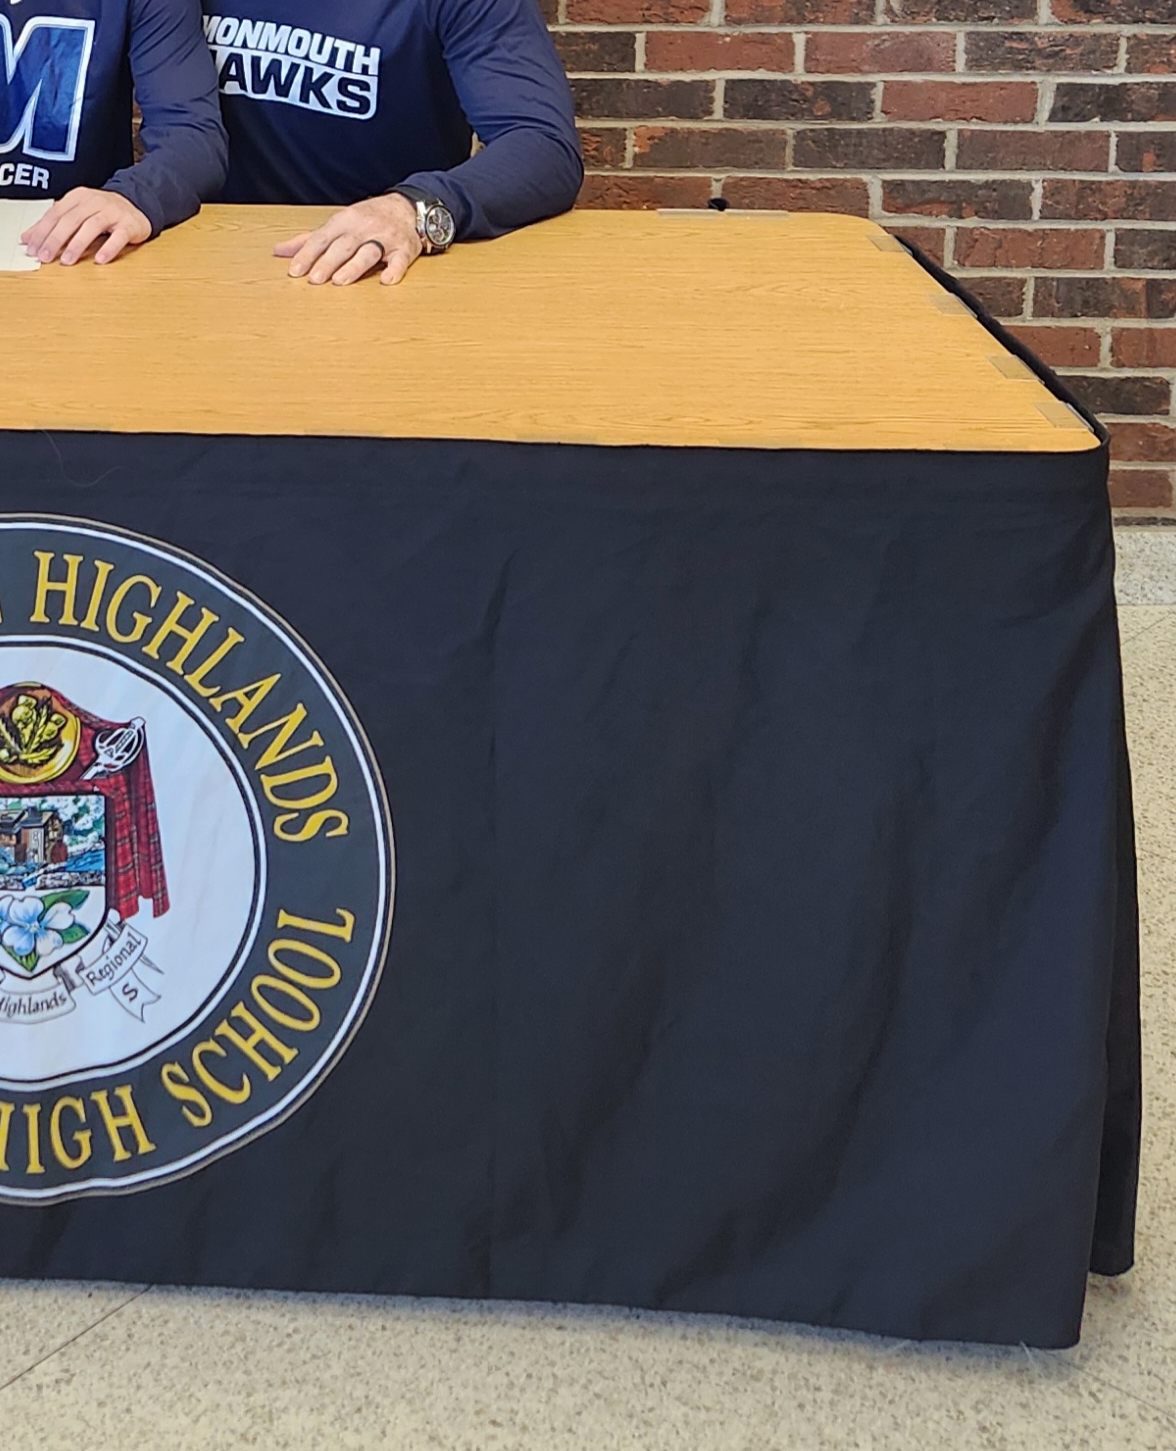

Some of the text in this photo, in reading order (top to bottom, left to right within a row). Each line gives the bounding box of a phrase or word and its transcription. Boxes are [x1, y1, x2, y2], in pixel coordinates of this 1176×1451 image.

[212, 48, 372, 116] AWKS
[29, 549, 351, 843] HIGHLANDS
[86, 931, 143, 987] Regional
[160, 905, 357, 1126] SCHOOL
